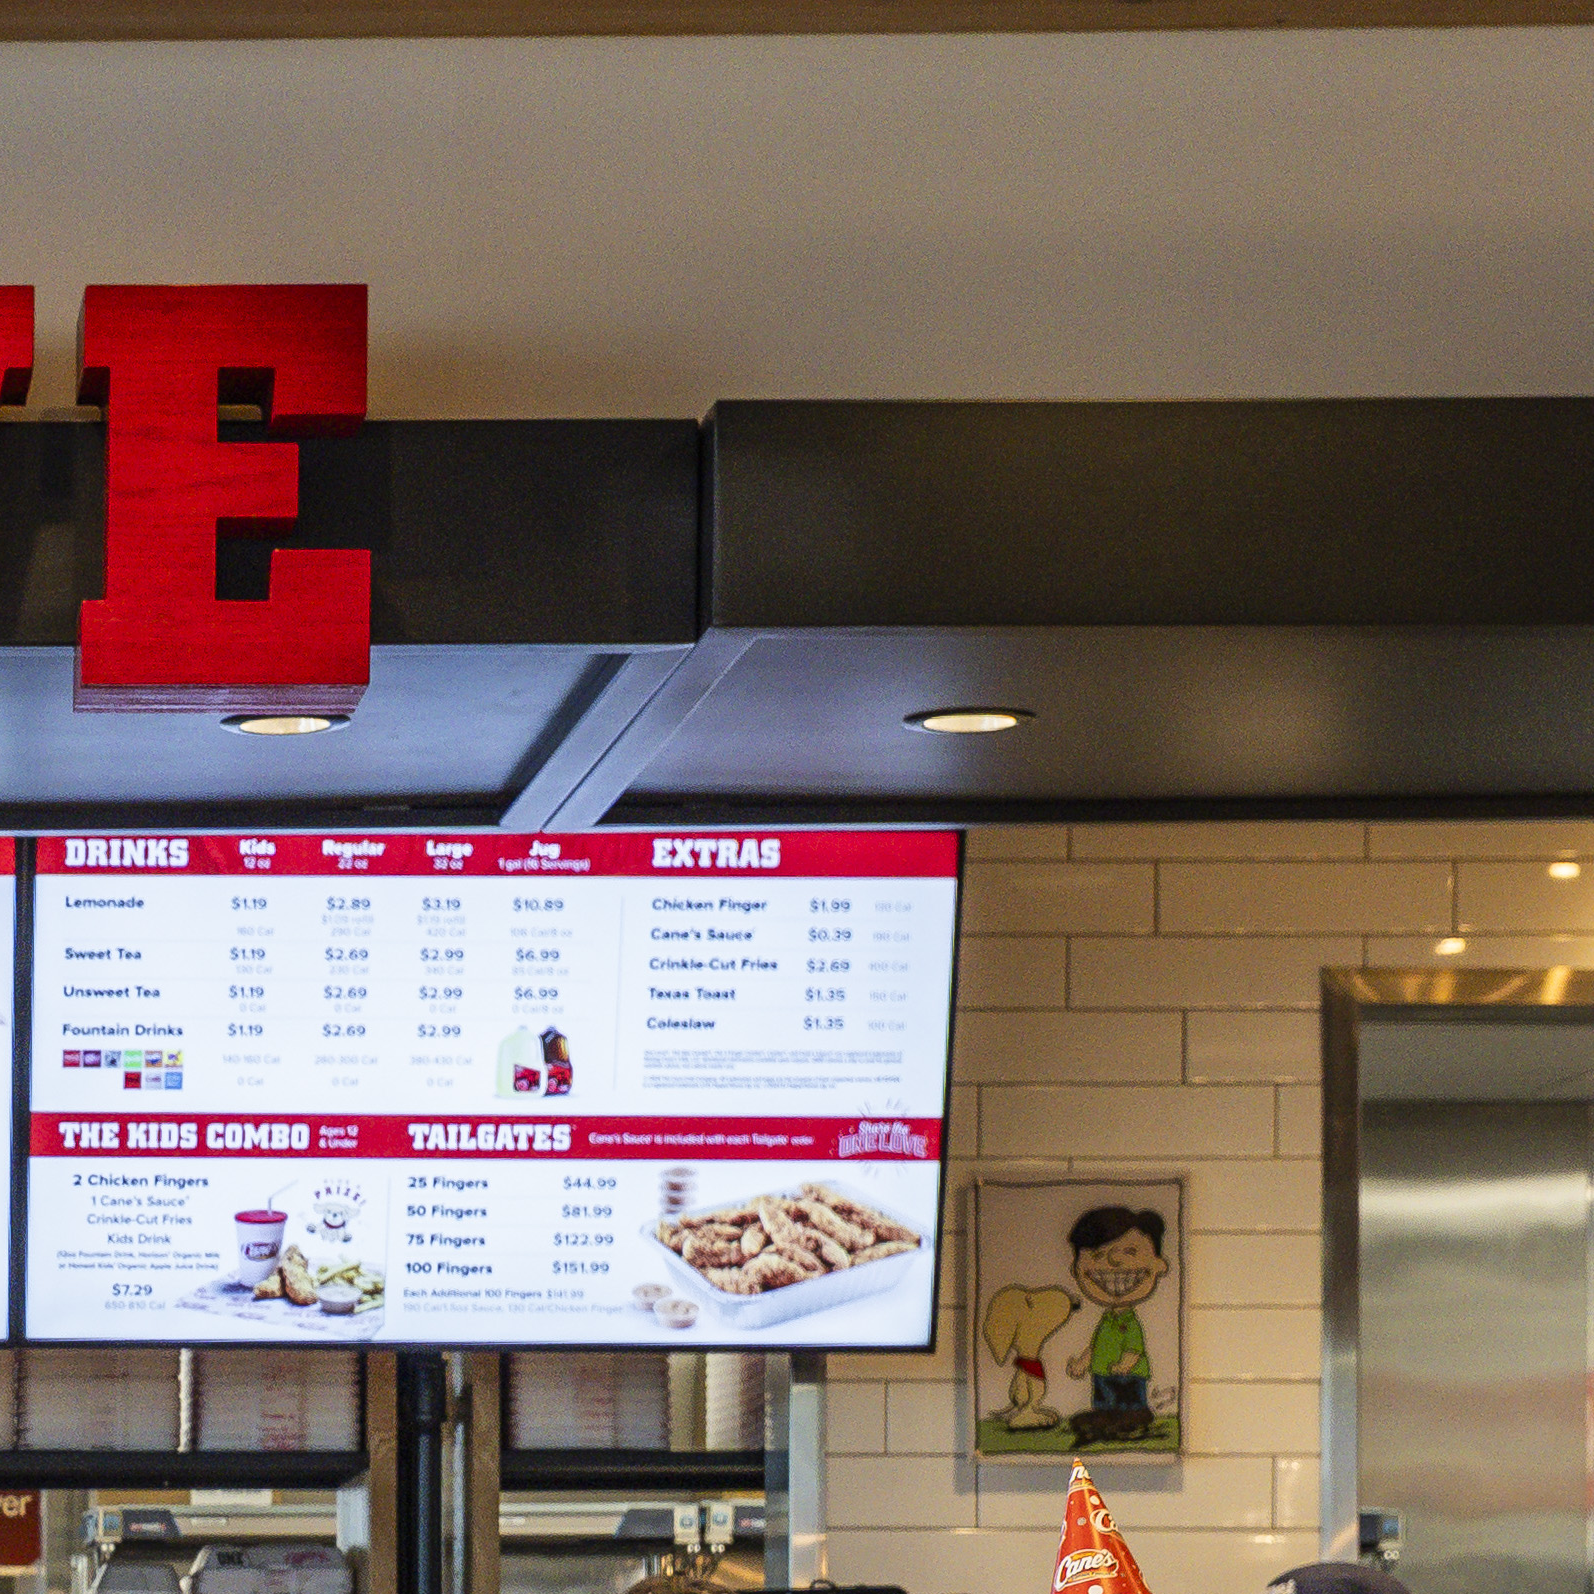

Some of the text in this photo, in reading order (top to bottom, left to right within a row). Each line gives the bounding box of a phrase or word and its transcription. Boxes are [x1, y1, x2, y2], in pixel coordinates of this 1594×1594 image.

[65, 839, 189, 868] DRINKS
[239, 837, 276, 858] Kids
[322, 839, 386, 859] Regular
[426, 840, 473, 859] Large
[528, 840, 561, 859] Jug
[652, 838, 780, 868] EXTRAS
[65, 896, 144, 908] Lemonade
[232, 897, 267, 910] $1.19
[652, 898, 767, 913] Chicken Finger
[65, 947, 141, 959] Sweet Tea
[64, 986, 160, 997] Unsweet Tea
[62, 1024, 183, 1036] Fountain Drinks
[228, 1023, 263, 1036] $1.19
[647, 1017, 715, 1029] Coleslaw
[323, 1024, 366, 1037] $2.69
[59, 1122, 310, 1150] THE KIDS COMBO
[408, 1123, 572, 1152] TAILGATES
[73, 1174, 208, 1189] 2 Chicken Fingers
[409, 1177, 488, 1191] 25 Fingers
[407, 1205, 487, 1220] 50 Fingers
[562, 1204, 612, 1218] $81.99
[107, 1233, 170, 1244] Kids Drink
[408, 1234, 485, 1249] 75 Fingers
[554, 1233, 614, 1246] $122.99
[406, 1262, 492, 1276] 100 Fingers
[553, 1260, 609, 1274] $151.99
[112, 1283, 153, 1296] $7.29
[1055, 1549, 1118, 1591] Cane's
